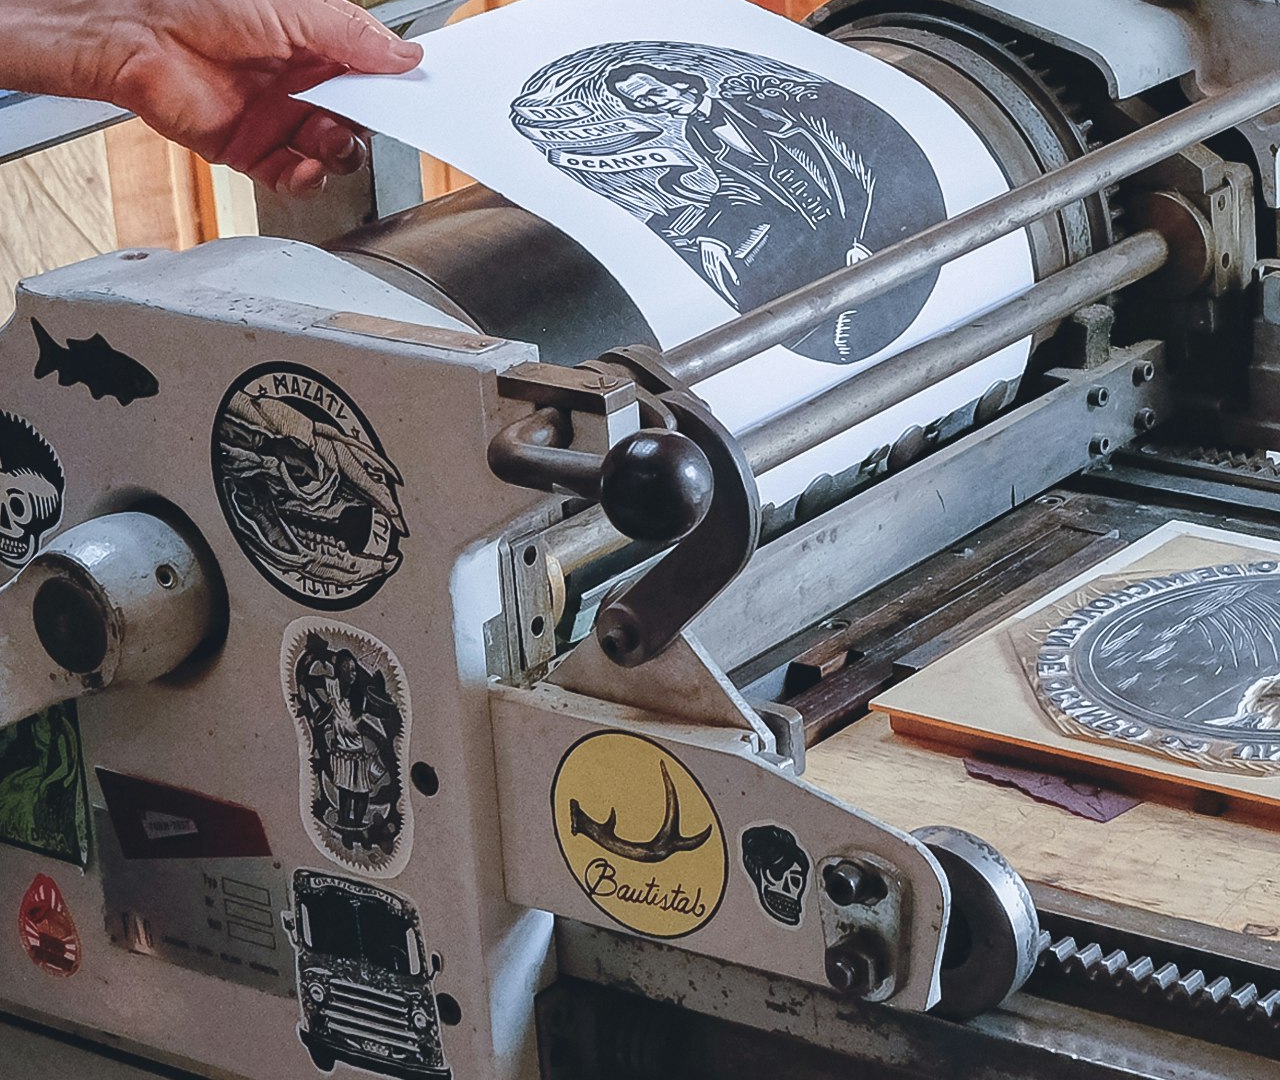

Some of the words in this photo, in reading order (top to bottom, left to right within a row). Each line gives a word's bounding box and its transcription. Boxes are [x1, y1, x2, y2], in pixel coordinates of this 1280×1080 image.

[528, 105, 580, 120] DON
[539, 120, 636, 142] MELCHOR
[565, 151, 669, 170] OCAMPO
[271, 373, 349, 421] MAZATL
[584, 856, 707, 918] Bautistab
